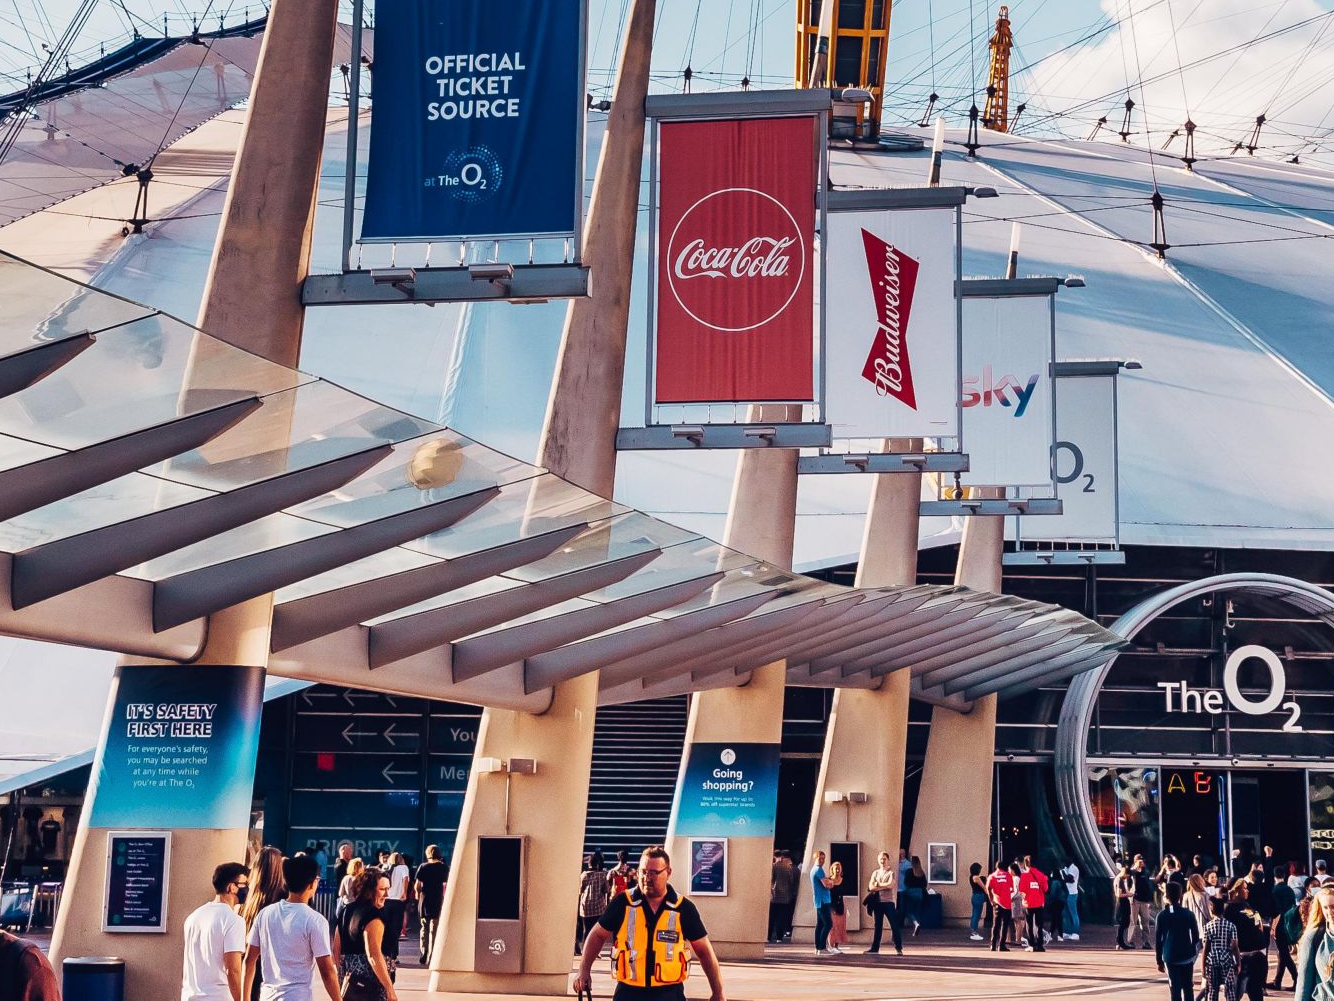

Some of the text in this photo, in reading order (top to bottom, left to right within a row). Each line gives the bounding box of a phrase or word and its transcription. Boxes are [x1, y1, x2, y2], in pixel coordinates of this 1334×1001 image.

[425, 52, 525, 75] OFFICIAL
[436, 76, 513, 97] TICKET
[427, 99, 519, 121] SOURCE
[424, 176, 436, 187] at
[438, 173, 460, 187] The
[675, 236, 797, 279] Coca-Cola
[874, 243, 896, 398] Budweiser
[961, 365, 1040, 418] sky
[1157, 644, 1303, 732] The O2
[126, 703, 217, 720] IT'S SAFETY
[127, 722, 213, 738] FIRST HERE
[127, 745, 209, 755] For everyone's safety,
[127, 756, 208, 766] you may be searched
[142, 769, 156, 777] any
[158, 768, 176, 776] time
[178, 768, 200, 776] while
[440, 766, 469, 780] Me
[713, 769, 743, 781] Going
[134, 780, 156, 788] you're
[169, 779, 184, 787] The
[702, 780, 754, 792] shopping?
[307, 839, 400, 857] PRIORITY
